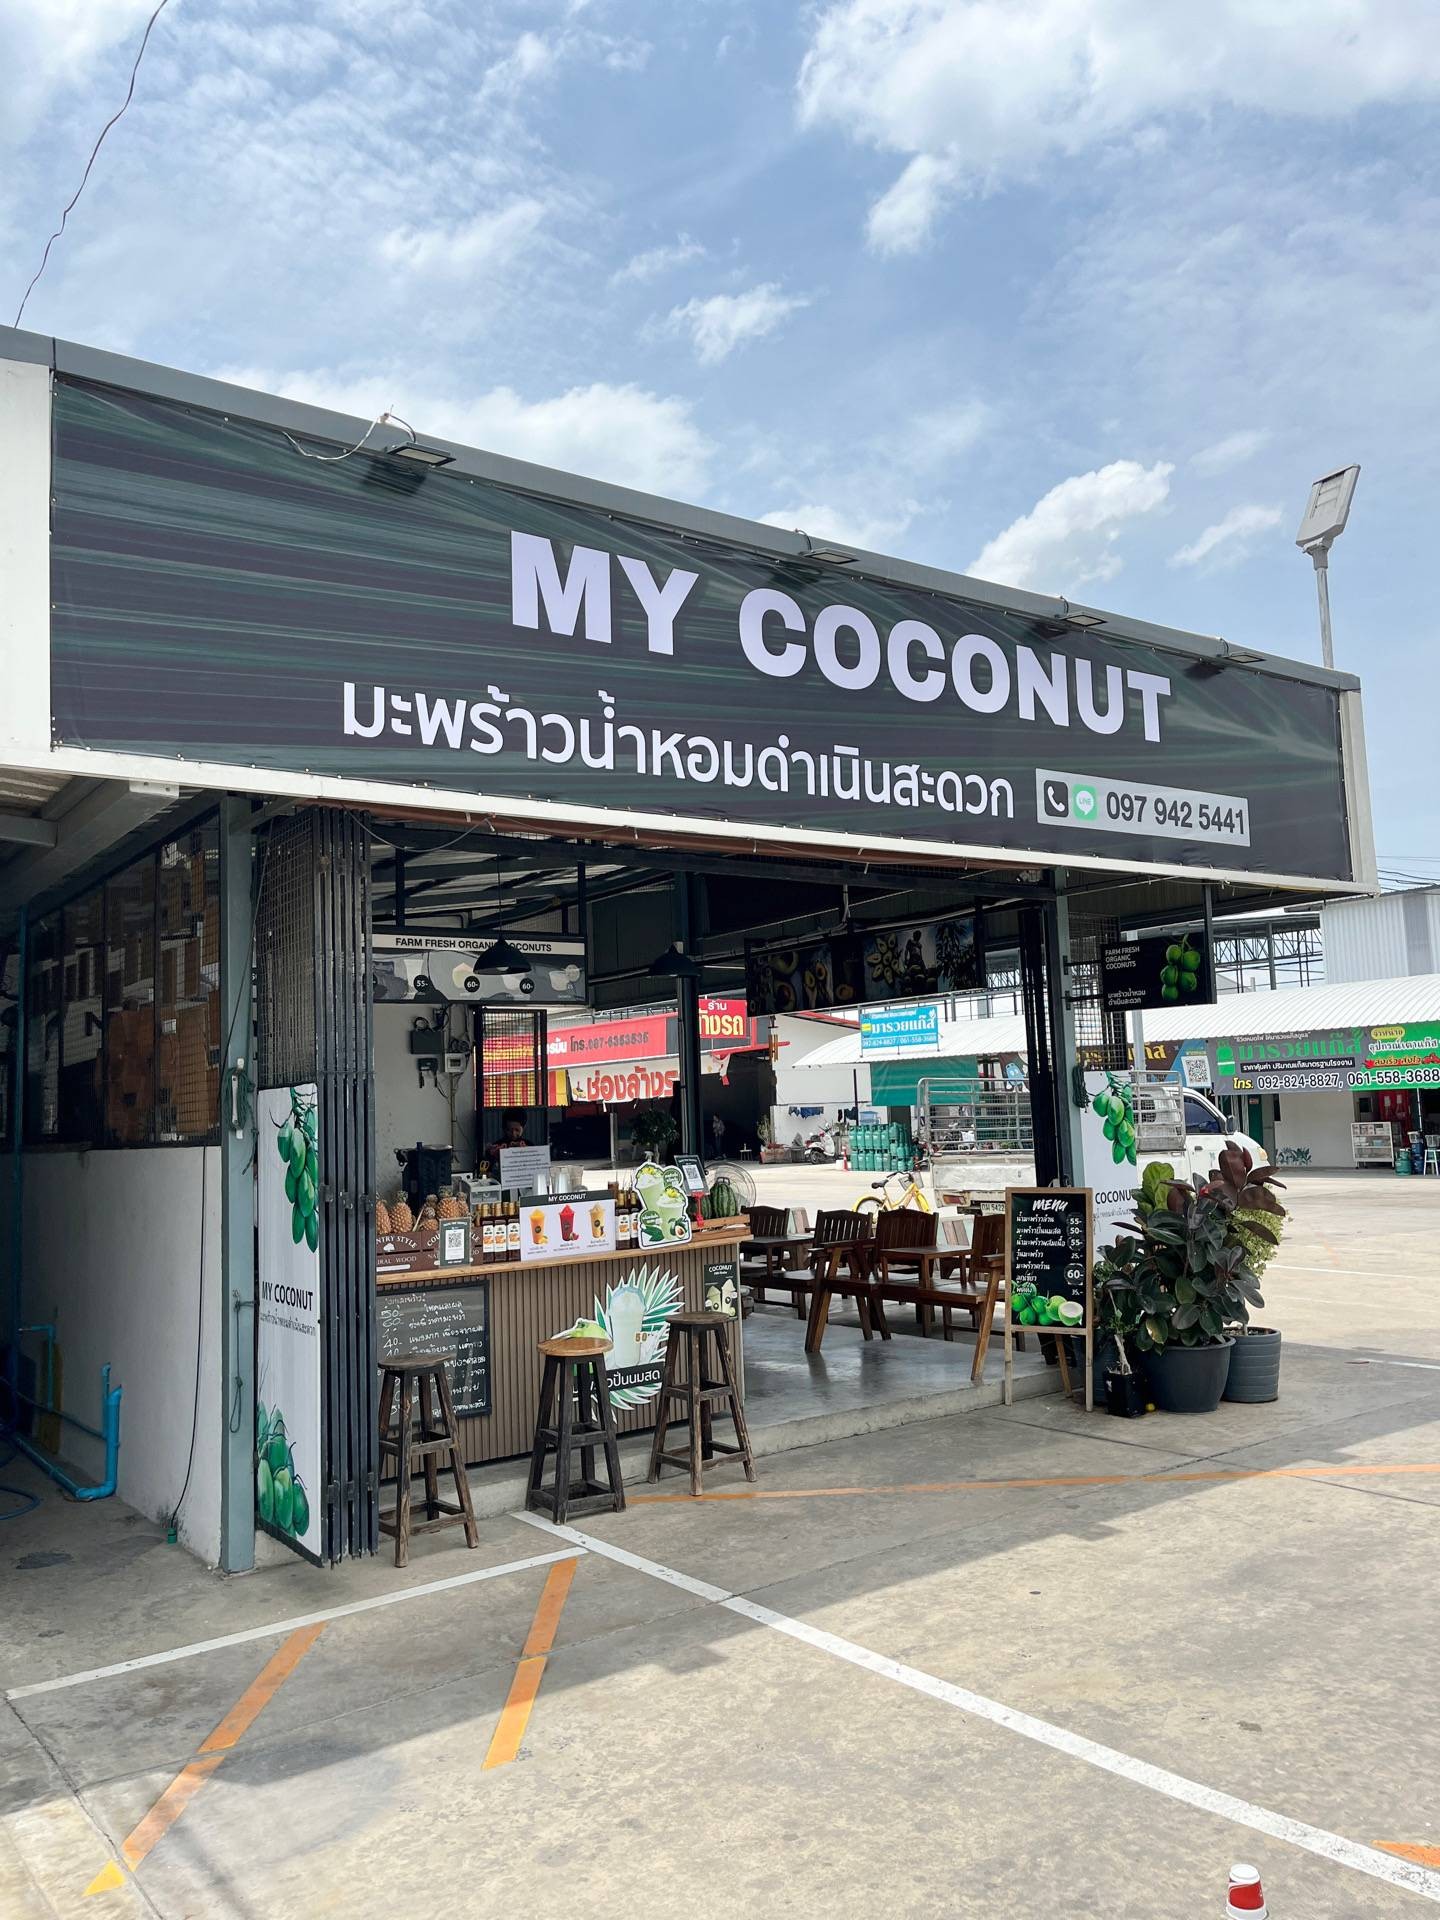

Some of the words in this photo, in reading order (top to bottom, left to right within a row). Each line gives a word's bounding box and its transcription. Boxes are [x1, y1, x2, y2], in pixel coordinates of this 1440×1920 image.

[511, 530, 699, 655] MY
[738, 588, 1172, 743] COCONUT
[343, 682, 1015, 819] มะพร้าวน้ำหอมดำเนินสะดวก
[1106, 791, 1147, 822] 097
[1154, 797, 1193, 828] 942
[1198, 803, 1245, 834] 5441
[396, 937, 422, 947] FARM
[425, 938, 456, 949] FRESH
[508, 942, 552, 952] OCONUTS
[1105, 948, 1120, 956] FARM
[1121, 946, 1140, 955] FRESH
[1105, 954, 1131, 963] ORGANIC
[1106, 960, 1137, 970] COCONUTS
[707, 1000, 727, 1010] ร้าน
[587, 1065, 679, 1101] ช่องล้างร
[1347, 1069, 1440, 1087] 061-558-3688
[559, 1193, 587, 1201] COCONUT
[1095, 1189, 1132, 1204] COCONU
[376, 1235, 395, 1245] NTRY
[397, 1235, 418, 1249] STYLE
[396, 1255, 417, 1263] WOOD
[708, 1264, 733, 1273] COCONUT
[262, 1281, 273, 1301] MY
[274, 1284, 314, 1312] COCONUT
[606, 1369, 661, 1389] วปั่นนมสด
